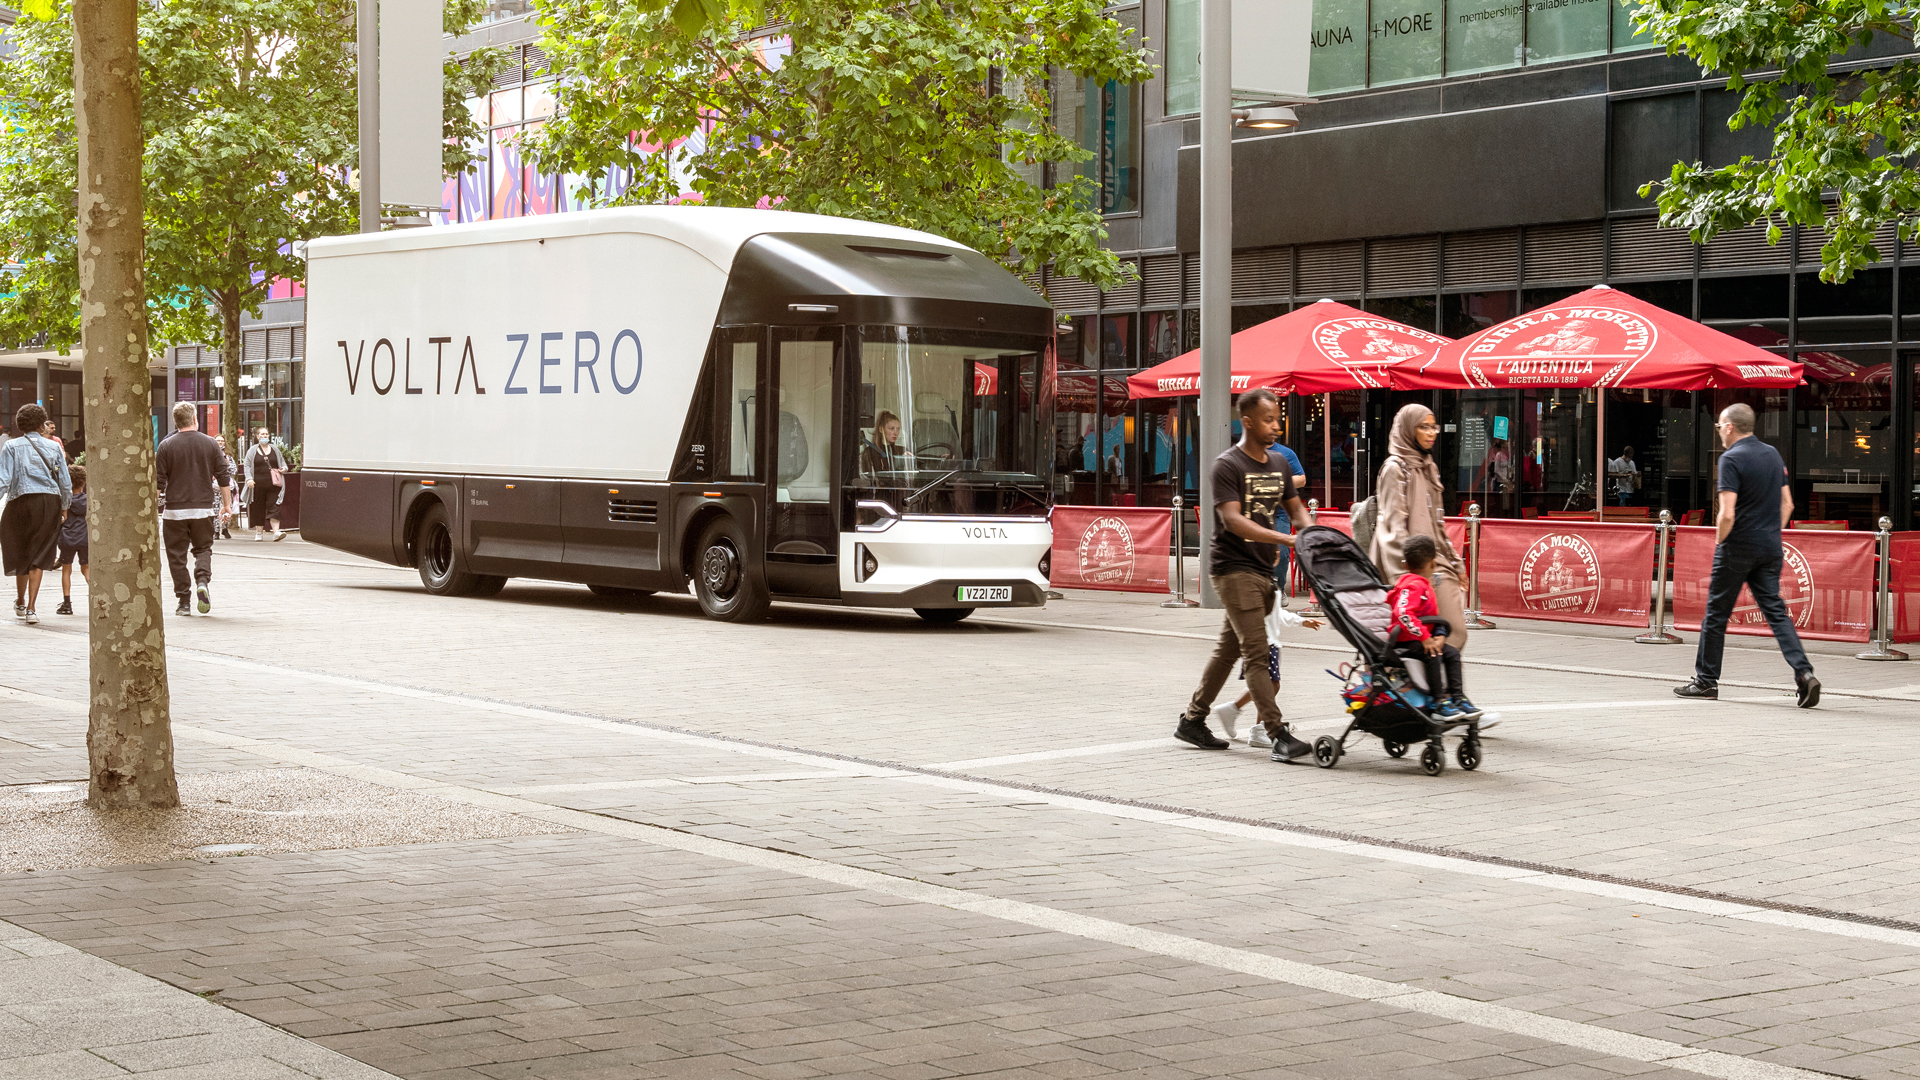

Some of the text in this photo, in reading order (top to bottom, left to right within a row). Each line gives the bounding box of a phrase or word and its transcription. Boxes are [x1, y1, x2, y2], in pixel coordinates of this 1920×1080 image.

[1459, 6, 1524, 24] memberships
[1310, 26, 1353, 48] AUNA
[1472, 308, 1650, 354] BIRRA MORETTI
[1319, 323, 1353, 359] BIRRA
[337, 329, 643, 396] VOLTA ZERO
[1496, 360, 1593, 375] L'AUTENTICA
[1508, 375, 1579, 385] RICETTA DAL 1859
[1736, 364, 1765, 379] BIRRA
[1157, 376, 1193, 392] BIRRA
[691, 444, 706, 453] ZERO
[962, 527, 1008, 539] VOLTA
[1081, 518, 1133, 567] BIRRA MORETTI
[1522, 535, 1598, 592] BIRRA MORETTI
[1781, 545, 1811, 593] RETTI
[966, 588, 1009, 600] VZ21 ZRO
[1541, 595, 1584, 611] L'AUTENTICA
